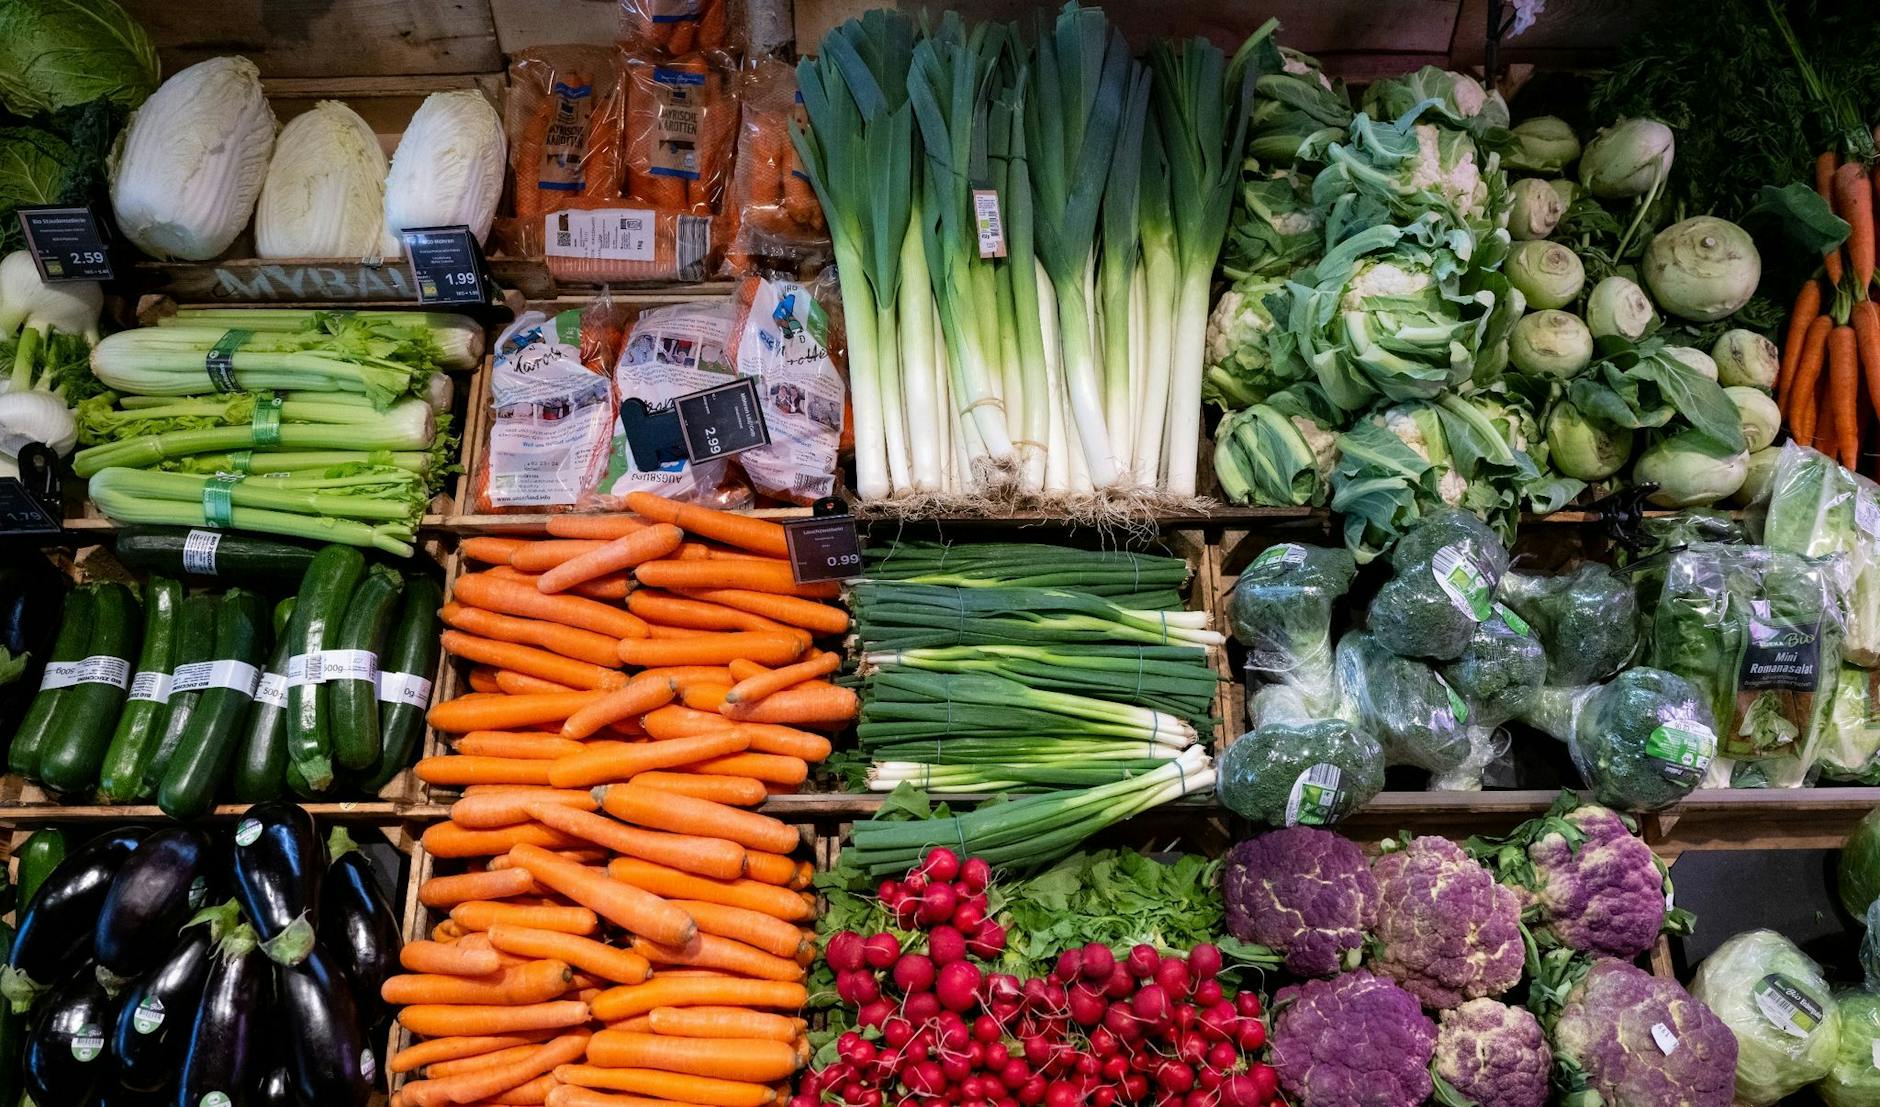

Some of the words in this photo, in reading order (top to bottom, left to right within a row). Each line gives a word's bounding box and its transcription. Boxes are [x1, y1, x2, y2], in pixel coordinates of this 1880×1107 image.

[70, 252, 104, 264] 2.59
[445, 272, 476, 286] 1.99
[705, 427, 721, 454] 2.99
[827, 554, 859, 567] 0.99
[1784, 632, 1815, 647] Bio
[1775, 652, 1798, 662] Mini
[1750, 663, 1813, 675] Romanasalat
